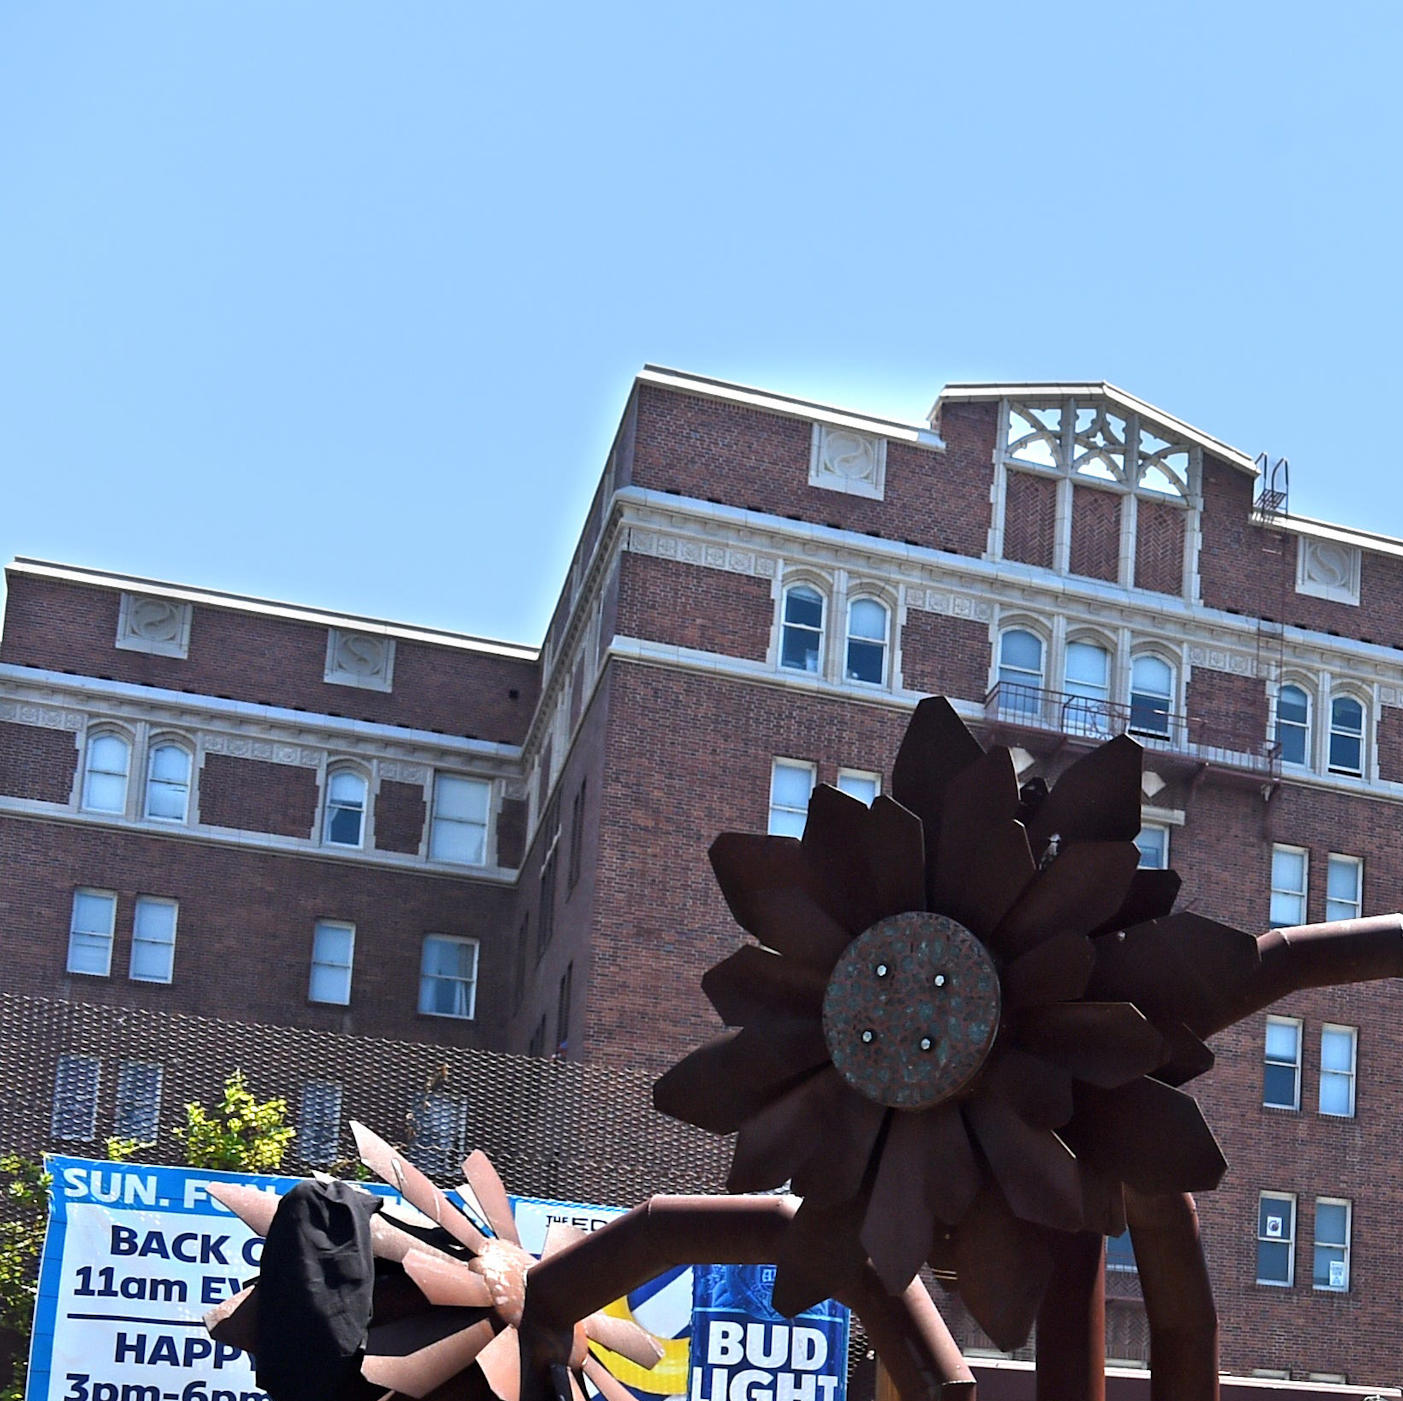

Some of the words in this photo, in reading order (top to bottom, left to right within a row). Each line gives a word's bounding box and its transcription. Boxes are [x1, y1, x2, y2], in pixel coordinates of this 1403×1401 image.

[63, 1167, 170, 1207] SUN.
[110, 1224, 230, 1265] BACK
[73, 1265, 187, 1303] 11am
[114, 1331, 256, 1372] HAPP
[707, 1320, 828, 1372] BUD
